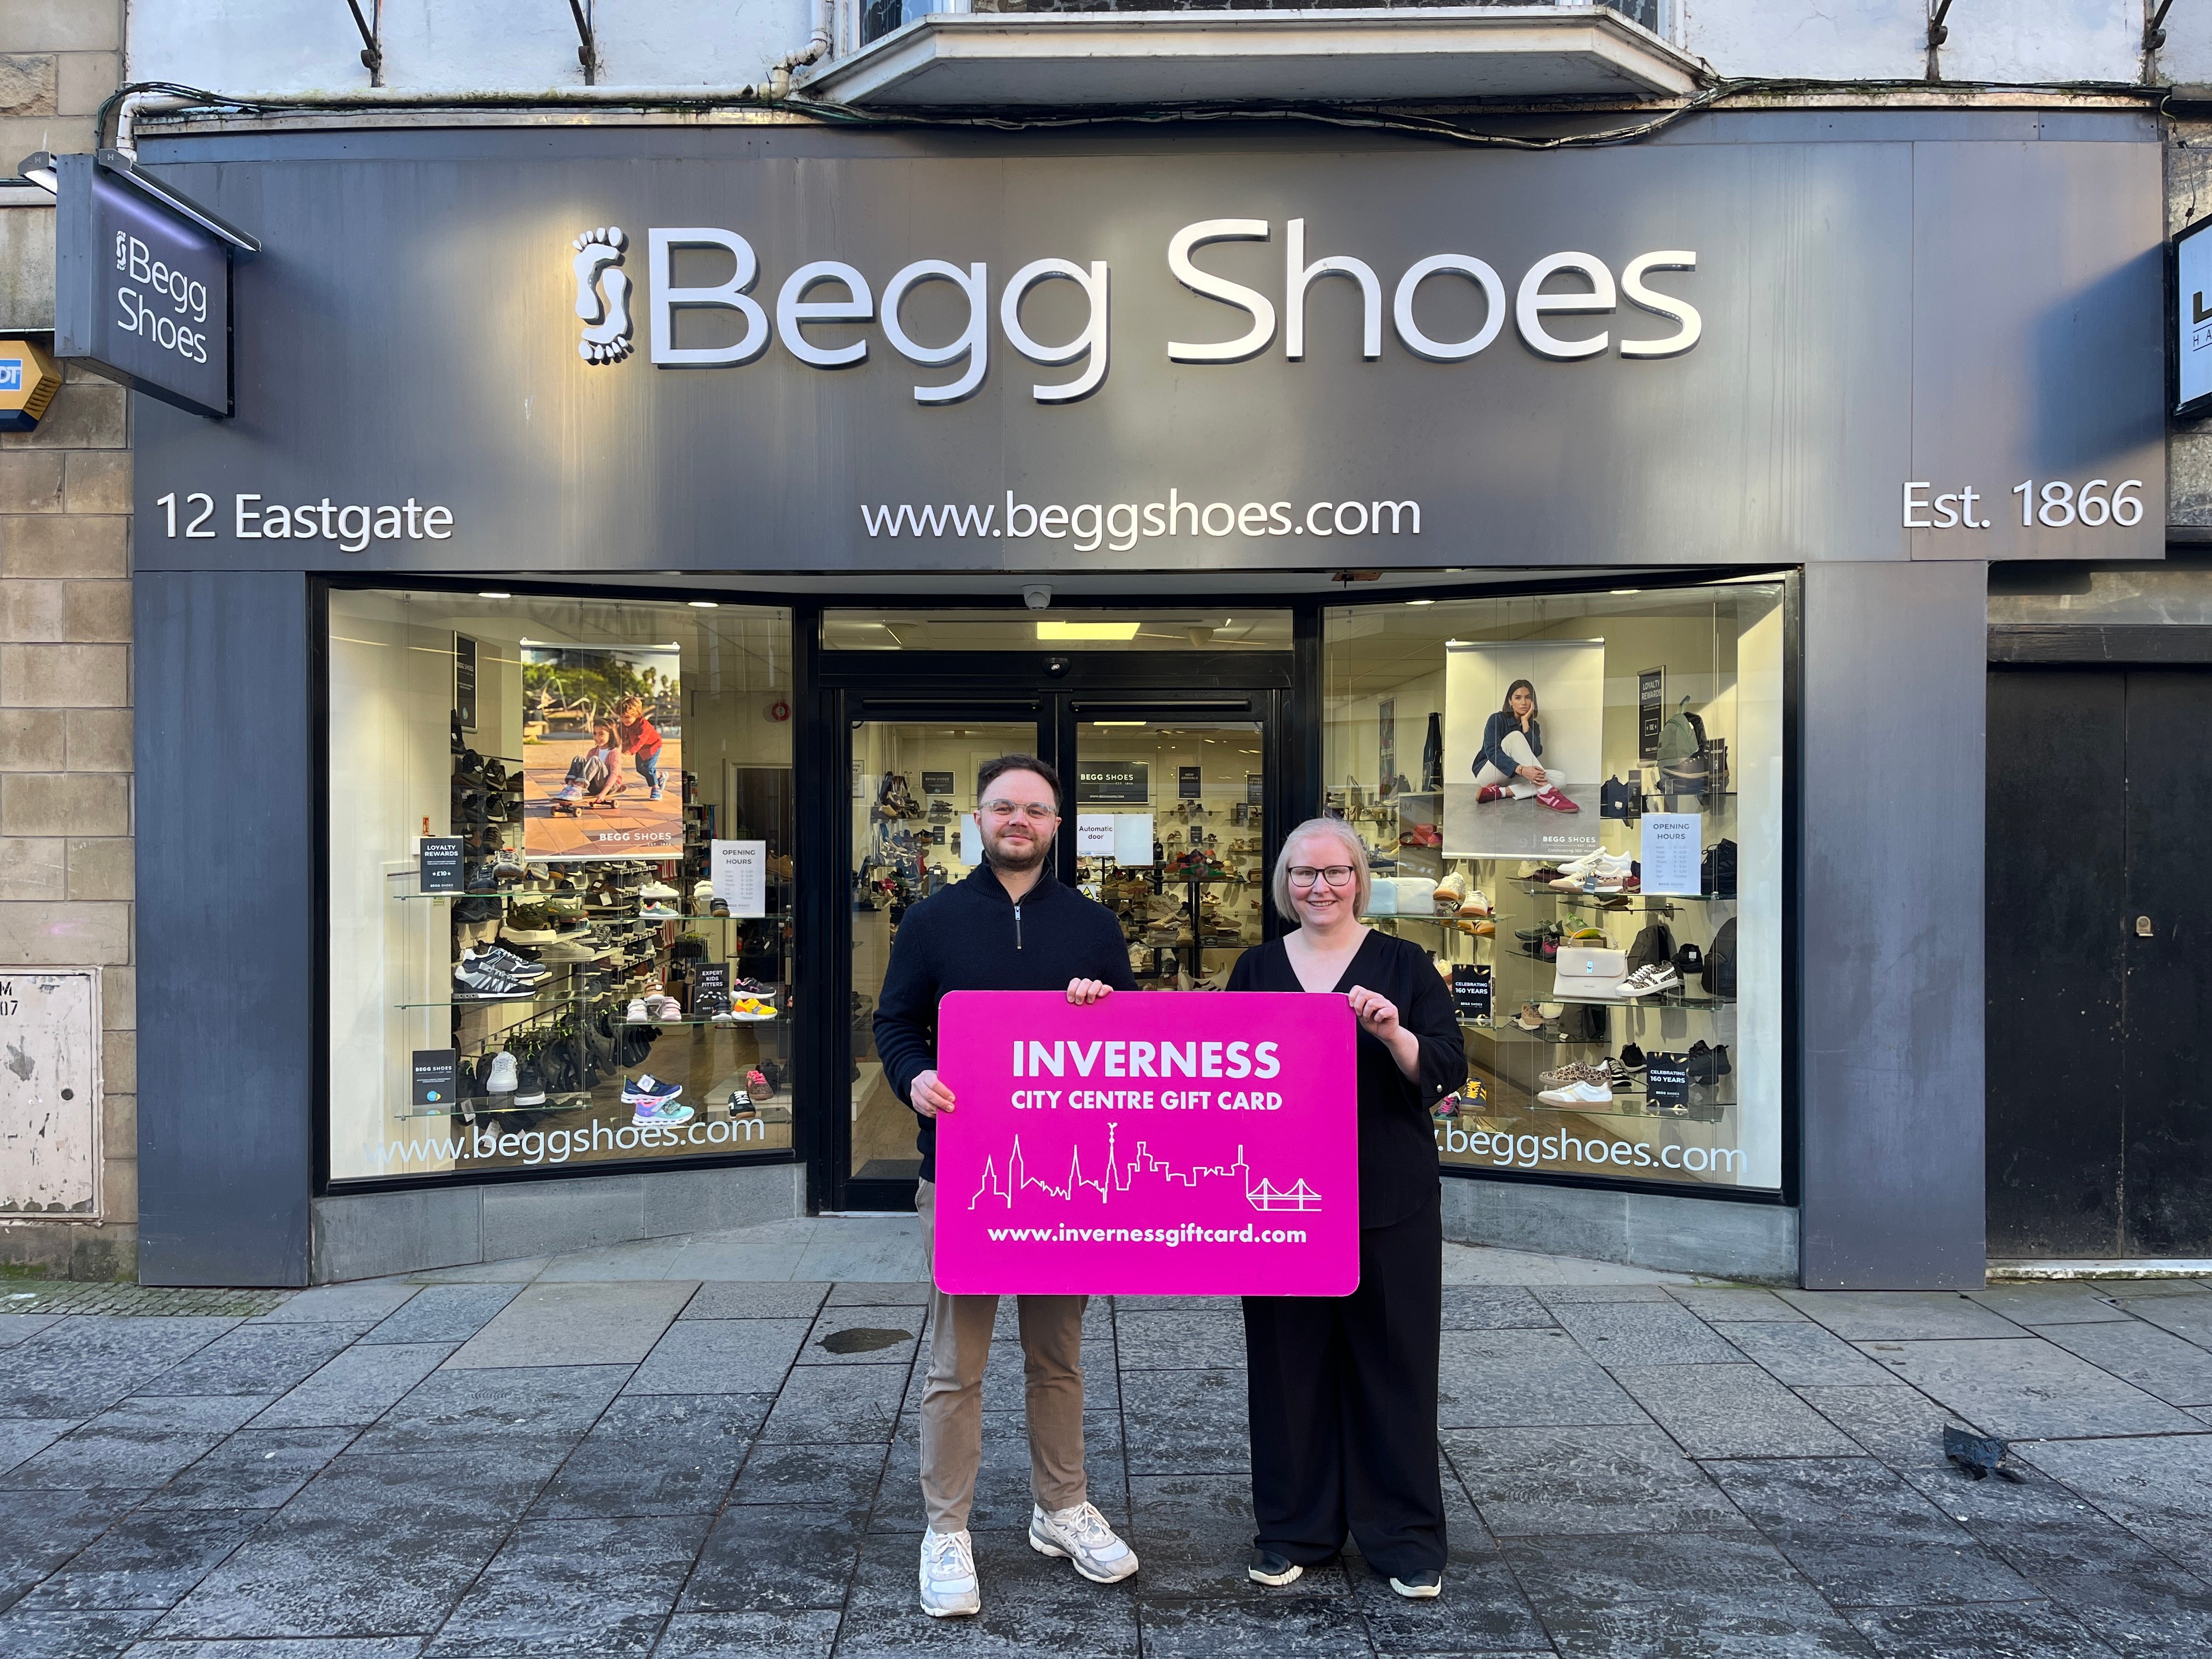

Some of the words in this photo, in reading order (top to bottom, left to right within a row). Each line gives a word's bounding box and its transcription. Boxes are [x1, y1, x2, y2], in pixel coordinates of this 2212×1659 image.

[129, 236, 207, 323] Begg
[117, 287, 207, 364] Shoes
[649, 227, 1109, 402] Begg
[1166, 218, 1703, 360] Shoes
[157, 492, 217, 538] 12
[236, 493, 454, 552] Eastgate
[860, 488, 1421, 551] www.beggshoes.com
[1903, 481, 1991, 528] Est.
[2012, 479, 2144, 527] 1866
[1641, 689, 1662, 701] REWARDS
[1643, 679, 1660, 691] LOYALTY
[599, 833, 630, 841] BEGG
[634, 832, 672, 840] SHOES
[1013, 1041, 1280, 1079] INVERNESS
[1011, 1090, 1062, 1109] CITY
[1068, 1091, 1154, 1109] CENTRE
[1160, 1091, 1211, 1110] GIFT
[1217, 1092, 1283, 1110] CARD
[363, 1118, 765, 1164] www.beggshoes.com
[1435, 1121, 1748, 1173] .beggshoes.com
[988, 1222, 1307, 1248] www.invernessgiftcard.com
